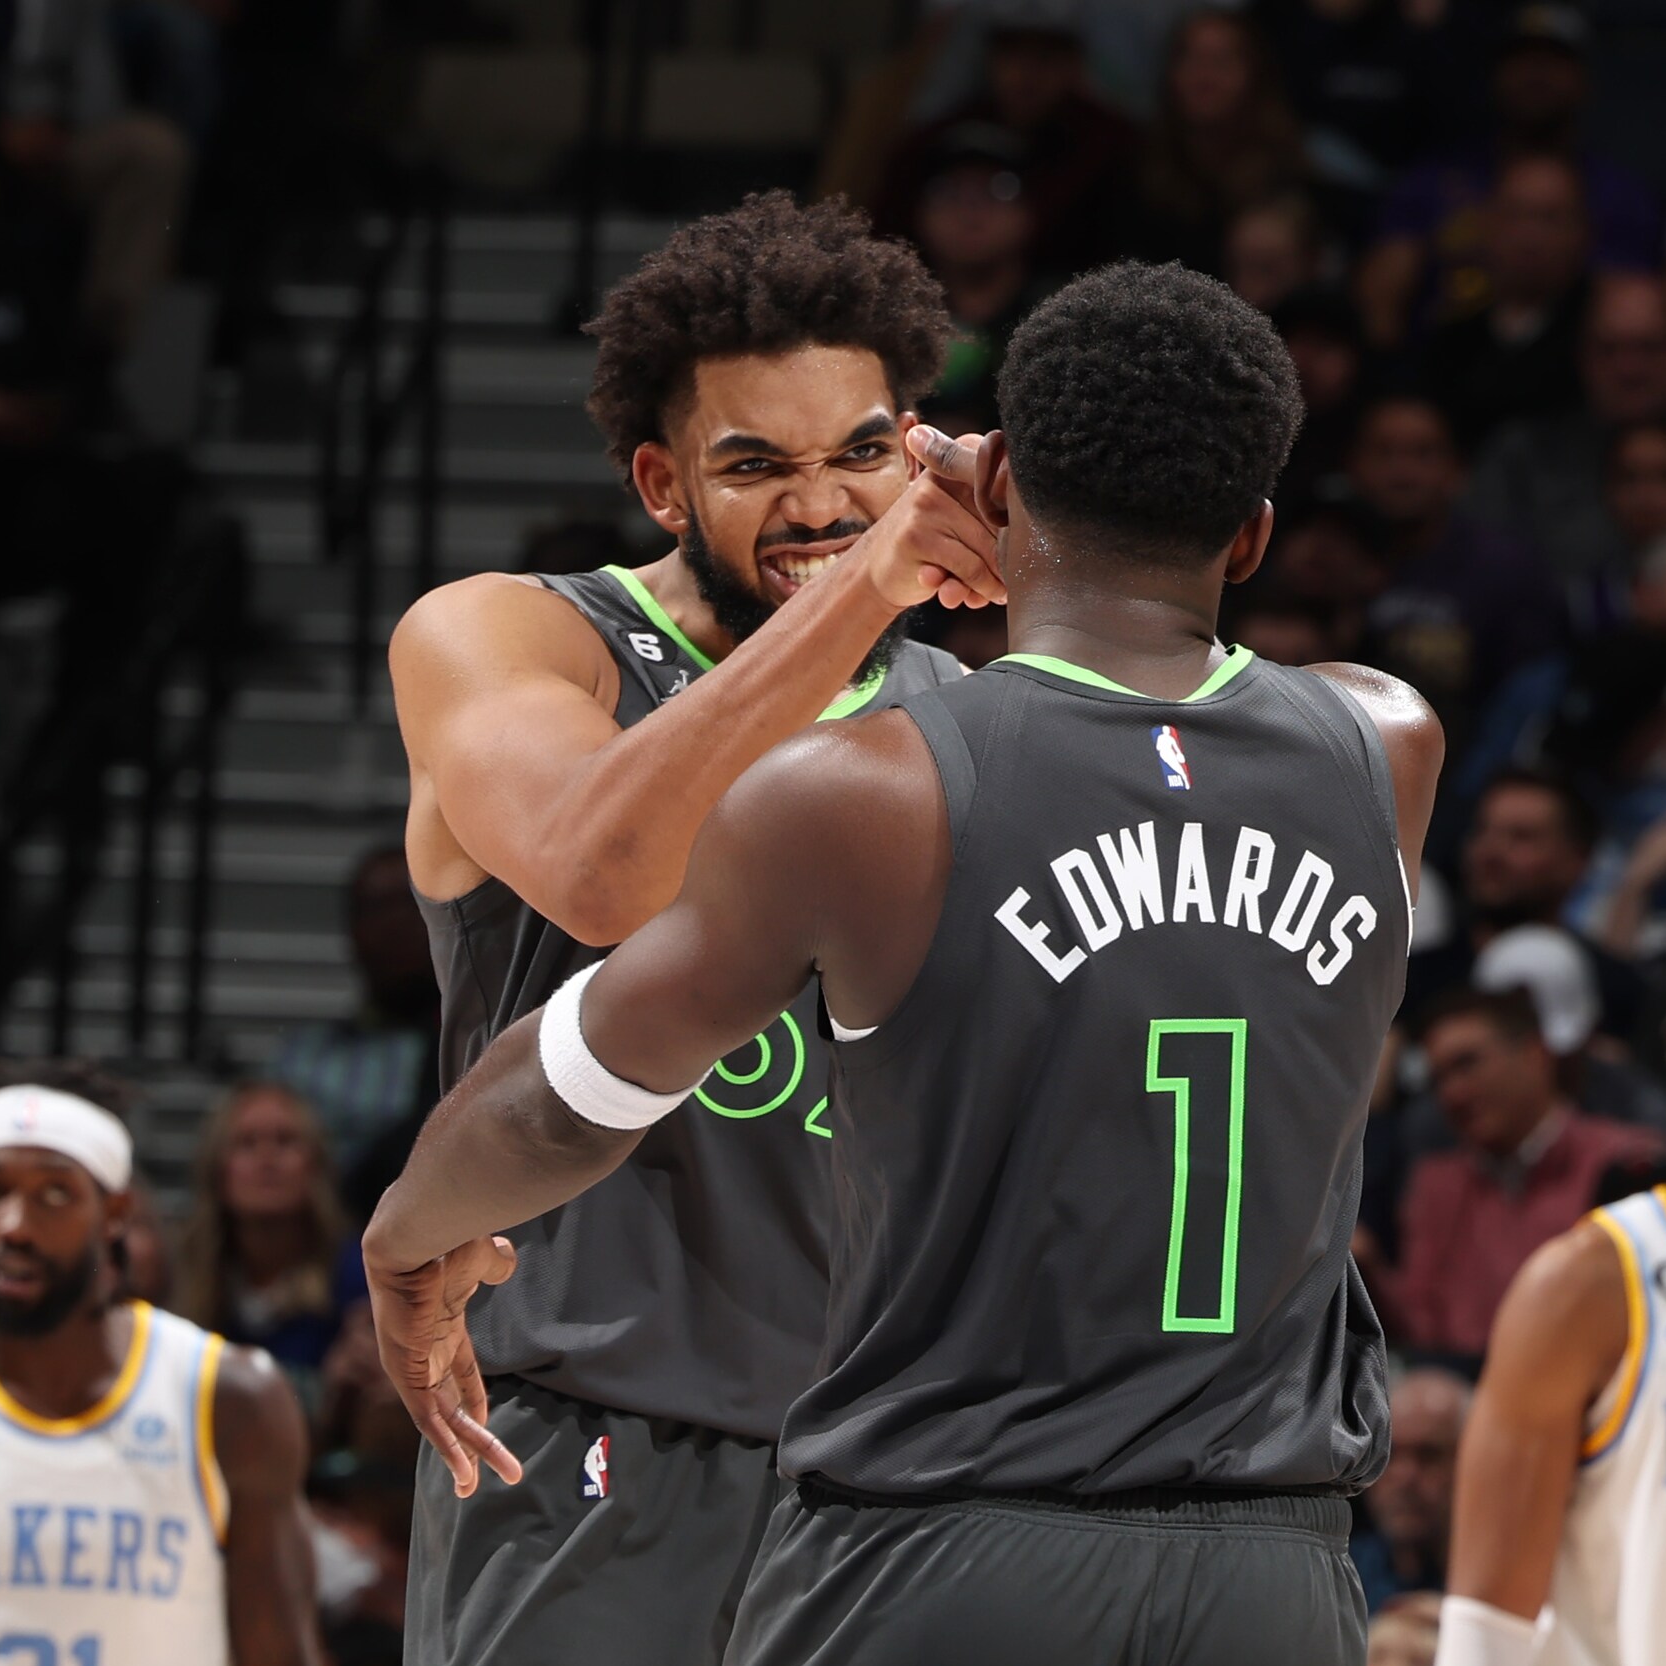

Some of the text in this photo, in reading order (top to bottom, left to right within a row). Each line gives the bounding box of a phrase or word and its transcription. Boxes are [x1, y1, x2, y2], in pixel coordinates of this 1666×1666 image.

[627, 632, 664, 662] 6
[993, 820, 1377, 986] EDWARDS
[1145, 1018, 1247, 1334] 1
